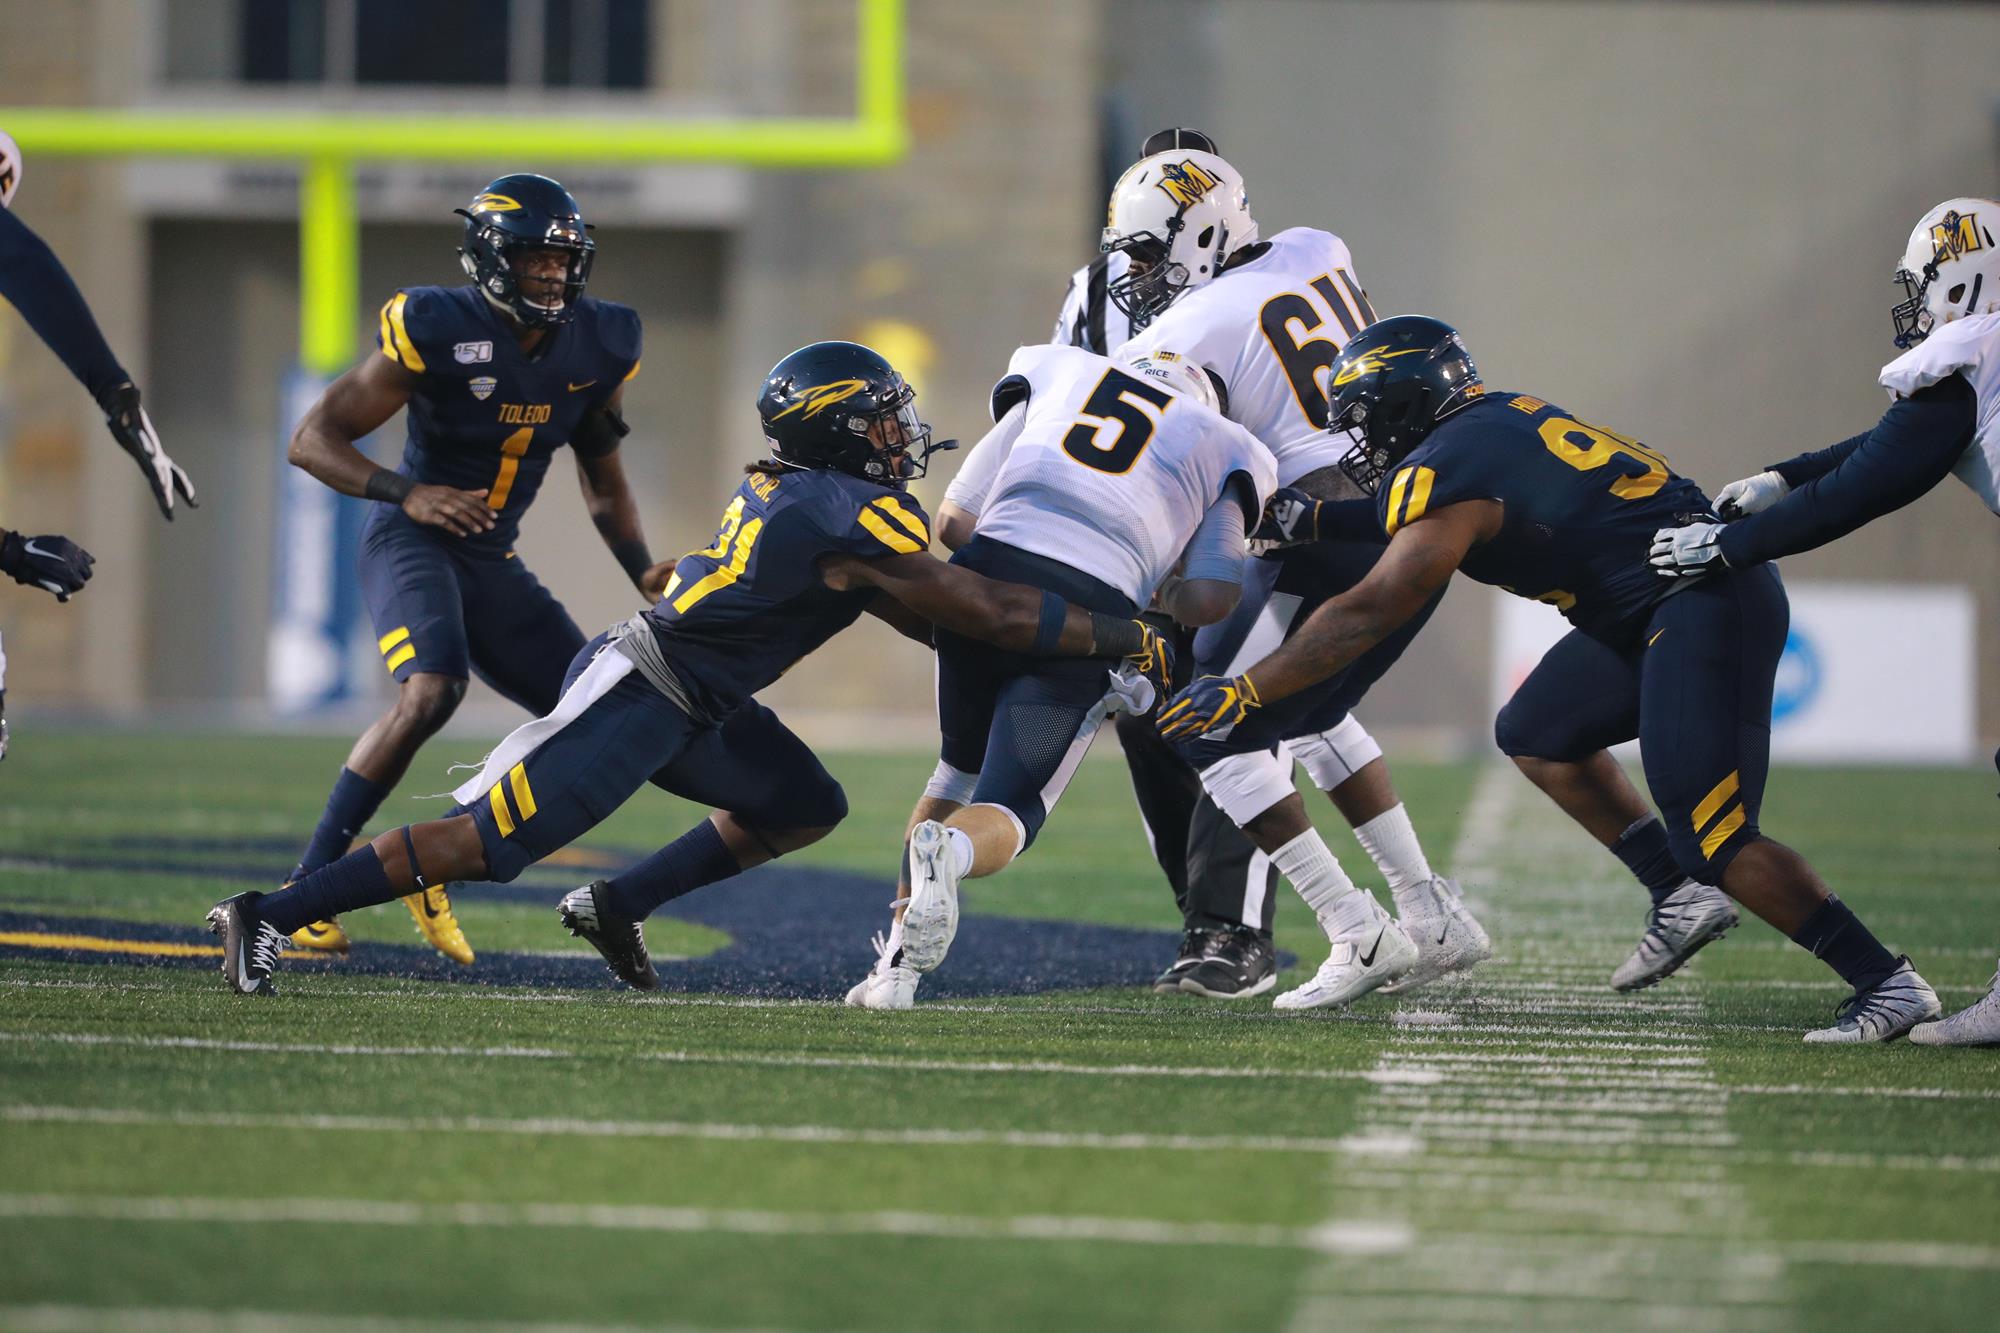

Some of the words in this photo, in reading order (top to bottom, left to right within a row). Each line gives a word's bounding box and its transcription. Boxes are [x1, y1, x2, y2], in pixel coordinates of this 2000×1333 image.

[498, 403, 552, 424] TOLEDO
[1144, 368, 1169, 379] RICE
[1061, 366, 1176, 477] 5
[1537, 416, 1669, 500] 9
[487, 427, 535, 510] 1
[662, 495, 764, 615] 21
